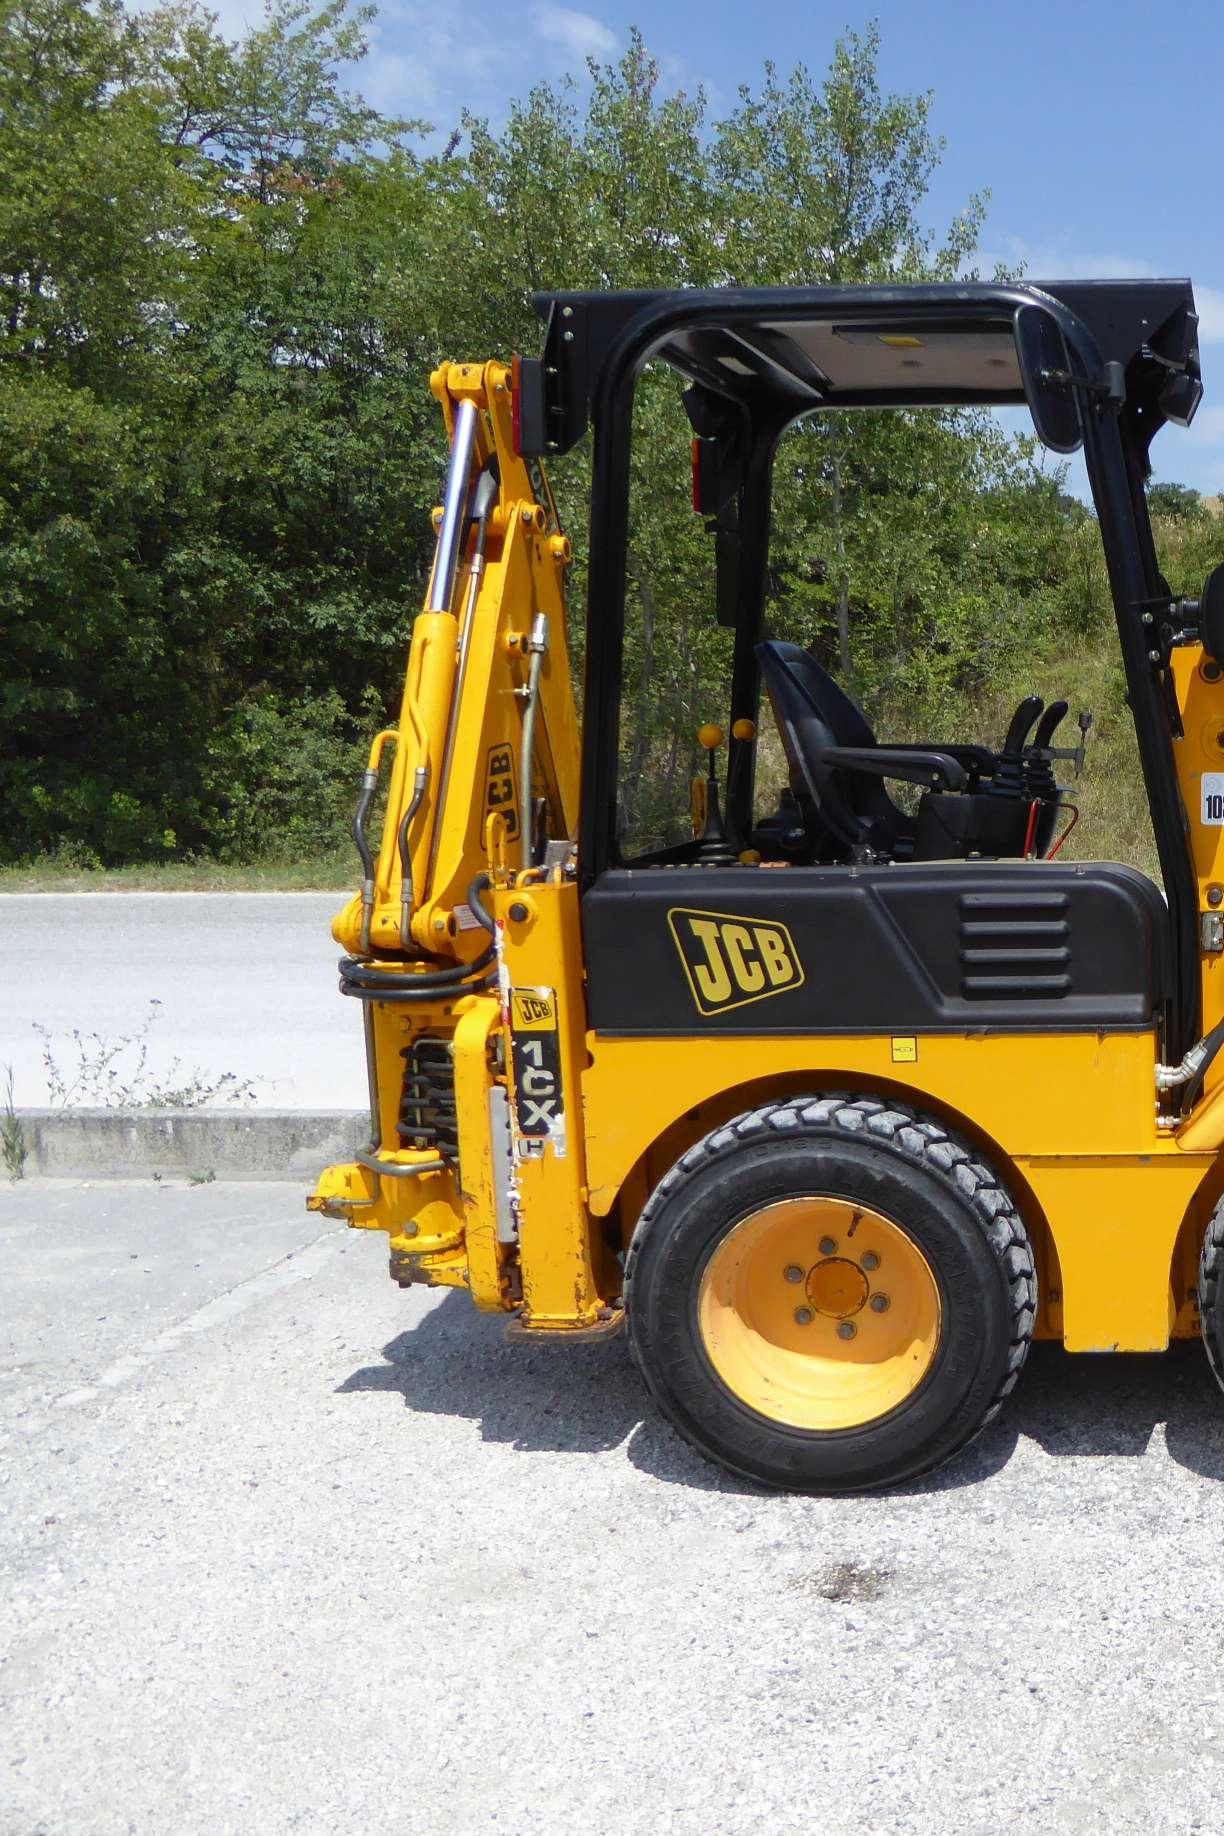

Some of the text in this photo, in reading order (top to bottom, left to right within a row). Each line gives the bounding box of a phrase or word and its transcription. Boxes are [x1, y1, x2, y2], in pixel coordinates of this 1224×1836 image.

[689, 918, 794, 1003] JCB
[521, 999, 550, 1021] JCB
[521, 1041, 557, 1126] 1CX
